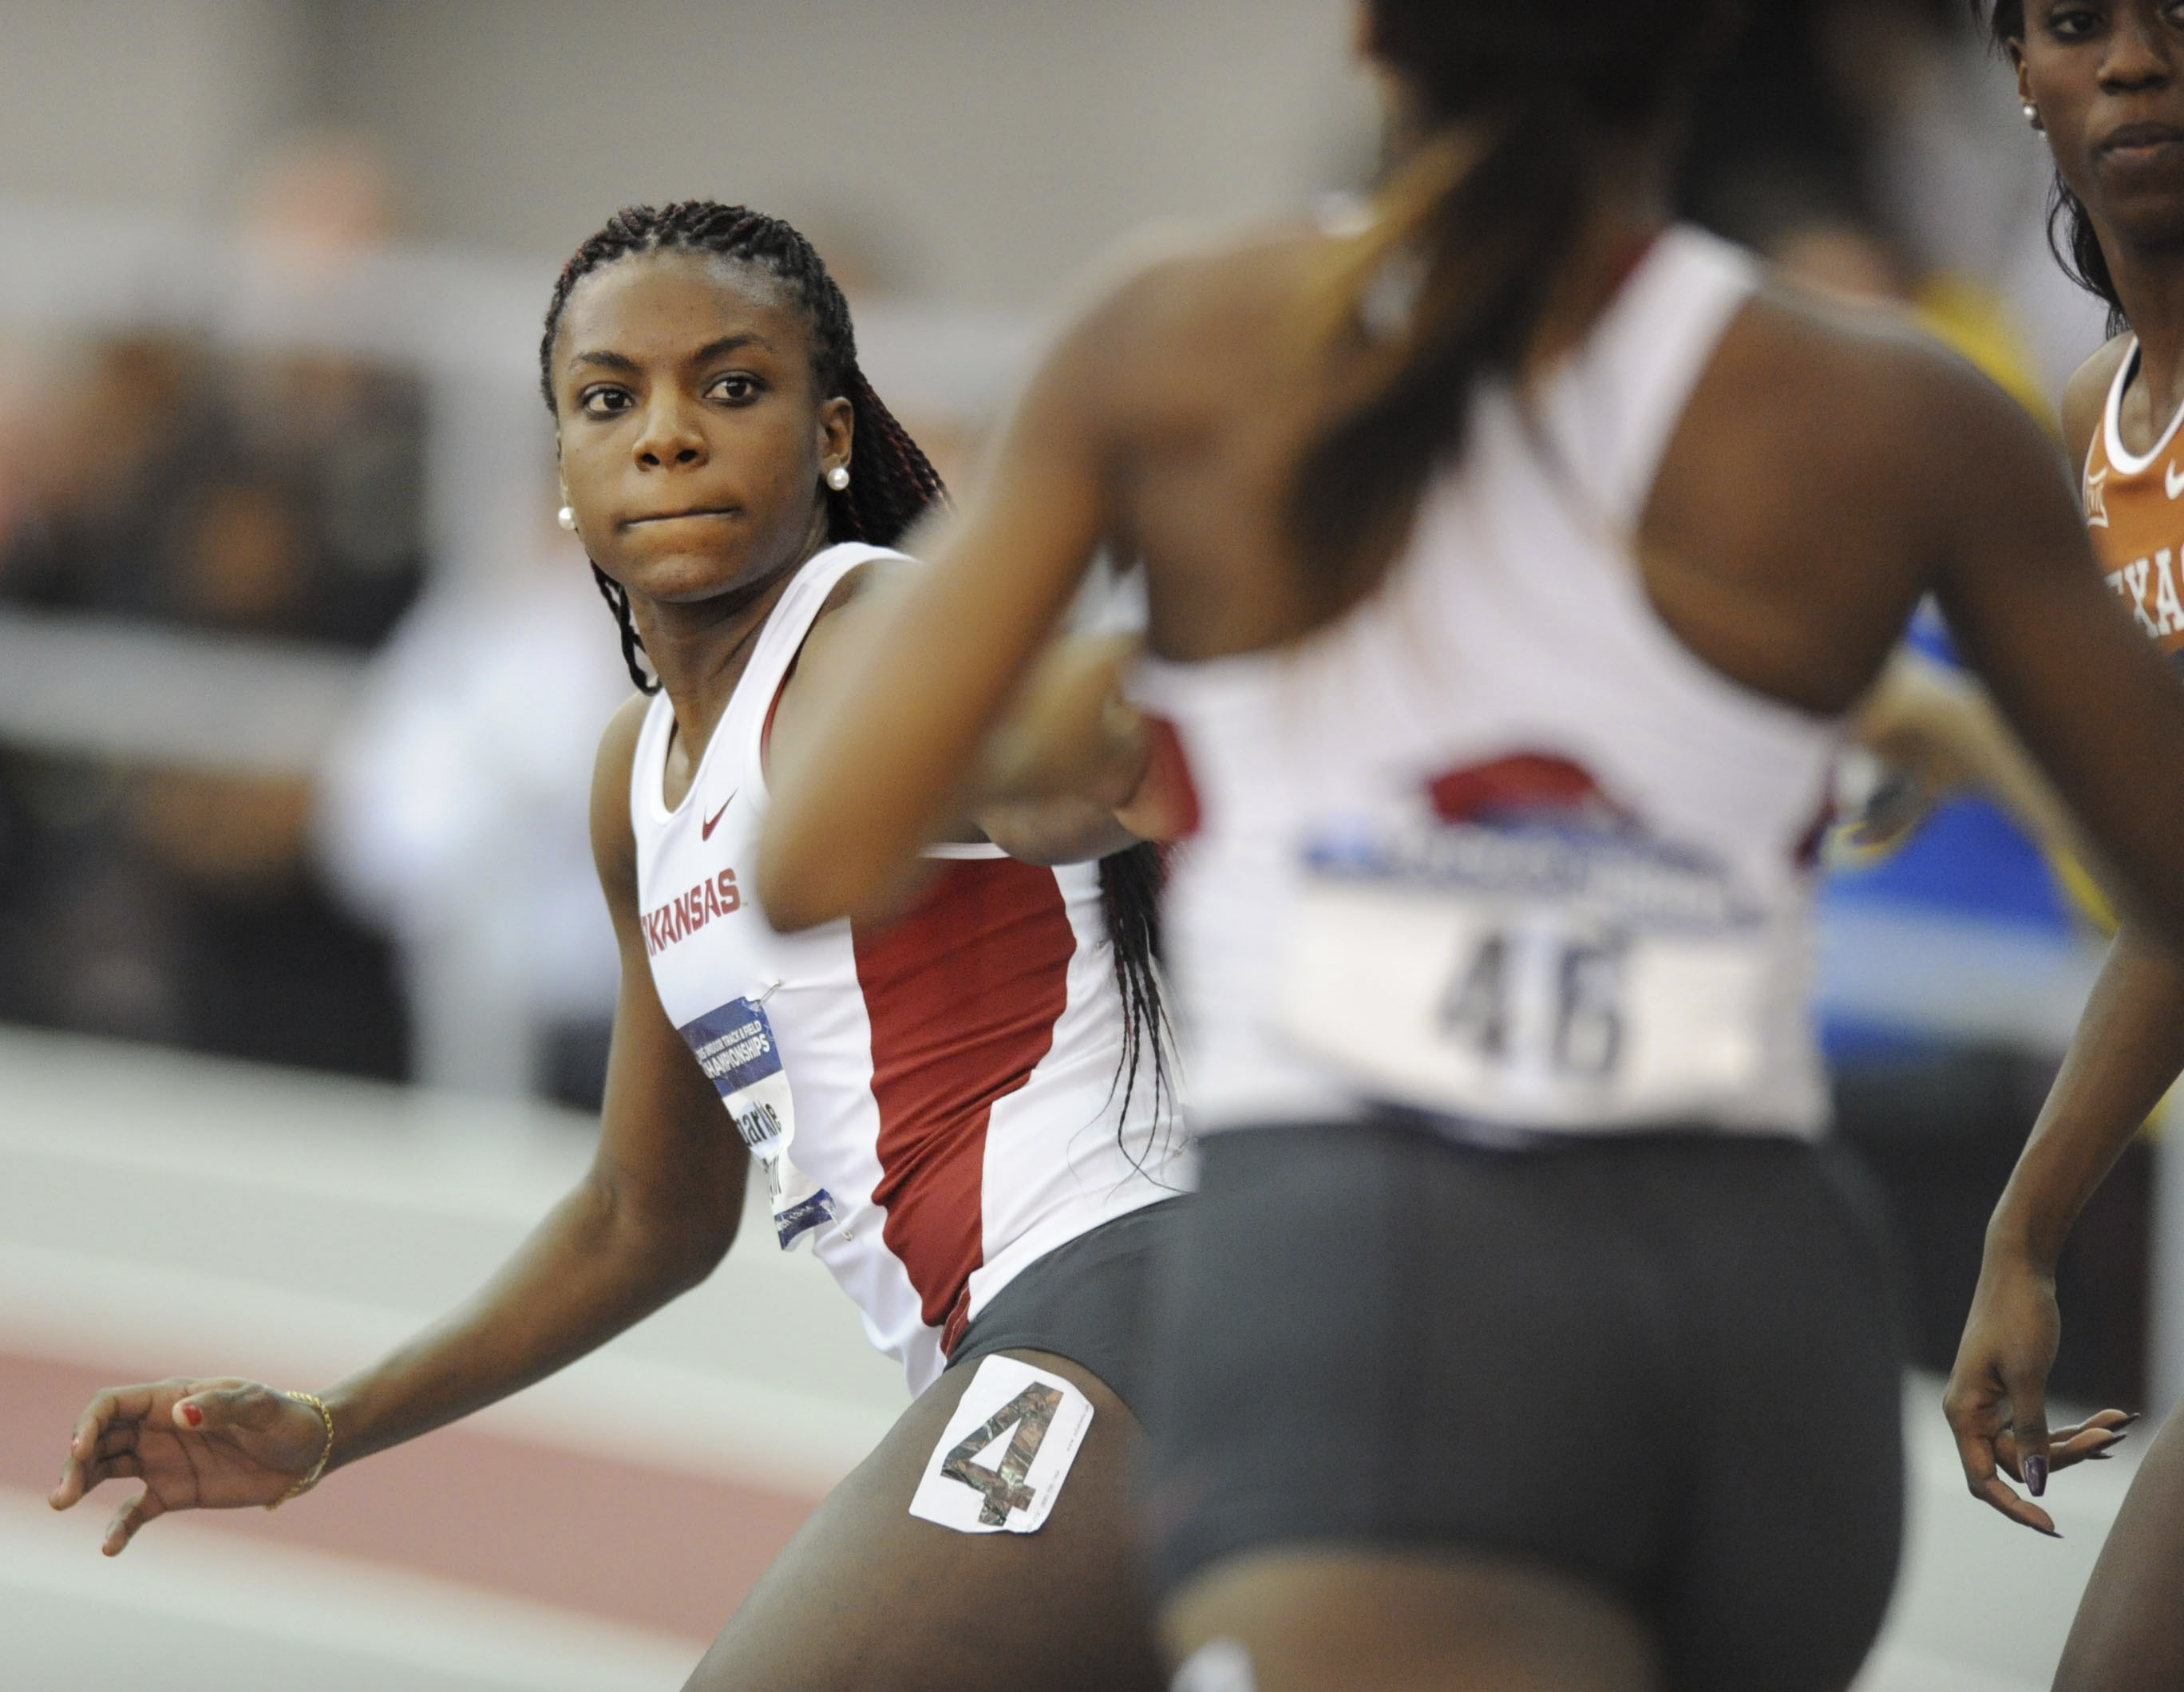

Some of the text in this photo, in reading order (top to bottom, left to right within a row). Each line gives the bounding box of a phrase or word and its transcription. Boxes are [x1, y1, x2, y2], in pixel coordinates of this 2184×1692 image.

[721, 1027, 742, 1048] TRACK
[742, 1019, 762, 1038] FIELD
[940, 1381, 1065, 1528] 4
